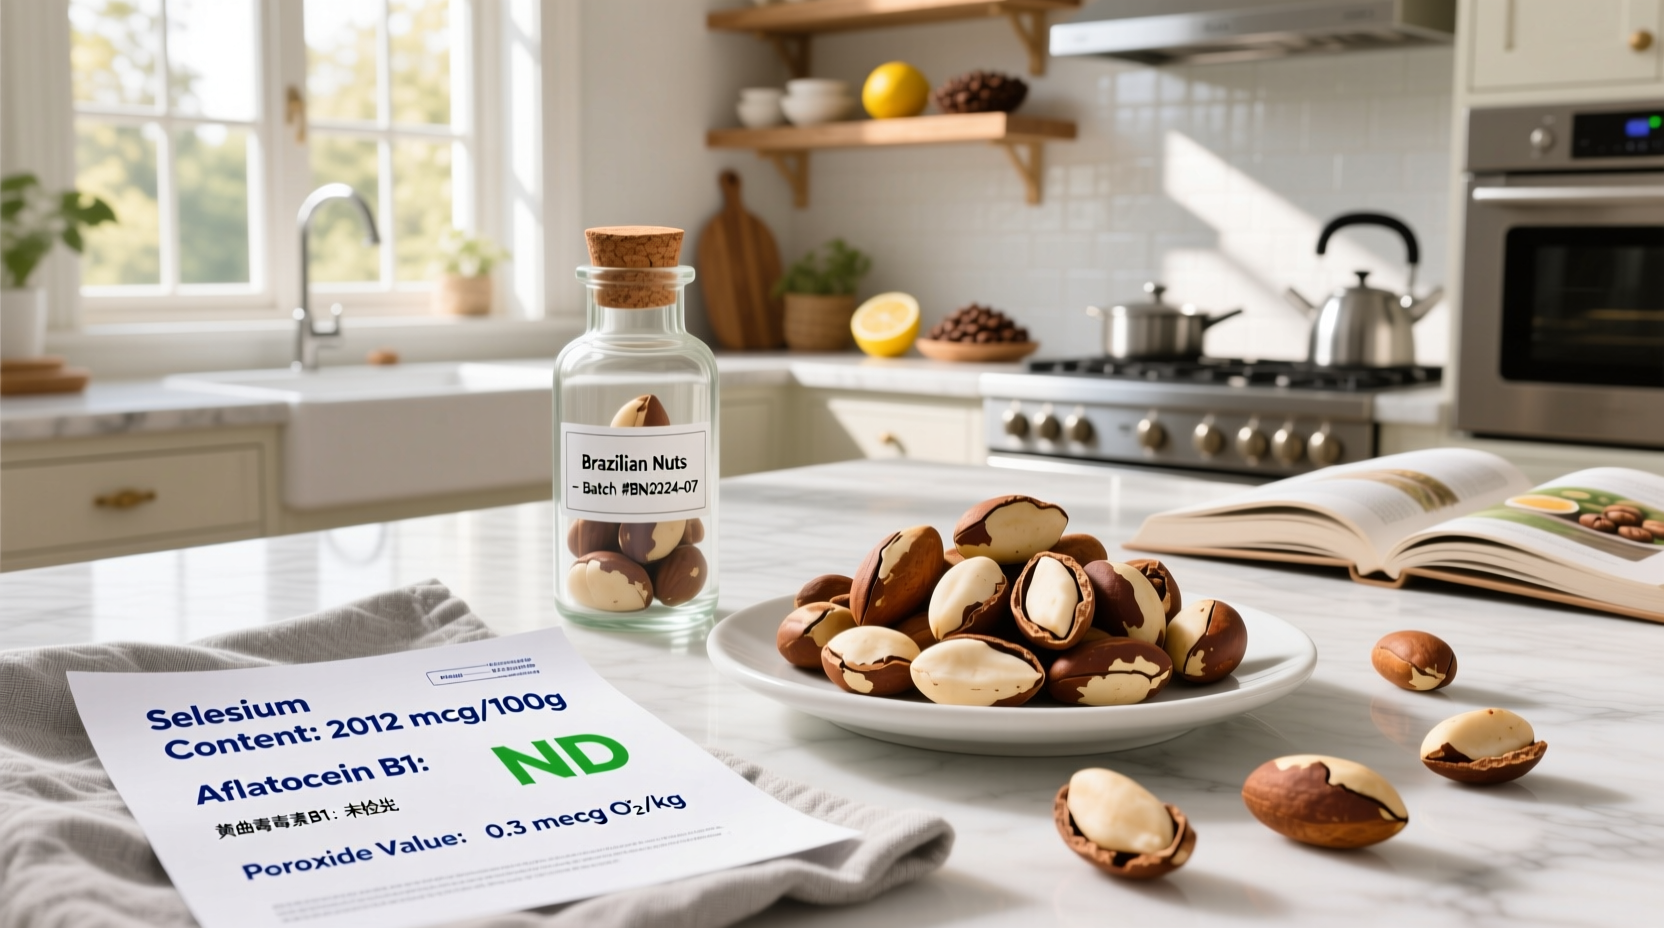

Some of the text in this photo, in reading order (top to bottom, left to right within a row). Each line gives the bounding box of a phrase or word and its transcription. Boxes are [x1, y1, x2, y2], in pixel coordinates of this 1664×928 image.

[582, 454, 687, 472] Brazilian Nuts
[583, 481, 617, 496] Batch
[146, 697, 311, 731] Selesium
[164, 692, 568, 760] Content: 2012 mcg/100g
[196, 754, 430, 806] Aflatocein B1:
[490, 733, 630, 786] ND
[242, 846, 373, 881] Poroxide
[375, 832, 467, 856] Value:
[485, 820, 527, 839] 0.3
[532, 808, 608, 832] mecg
